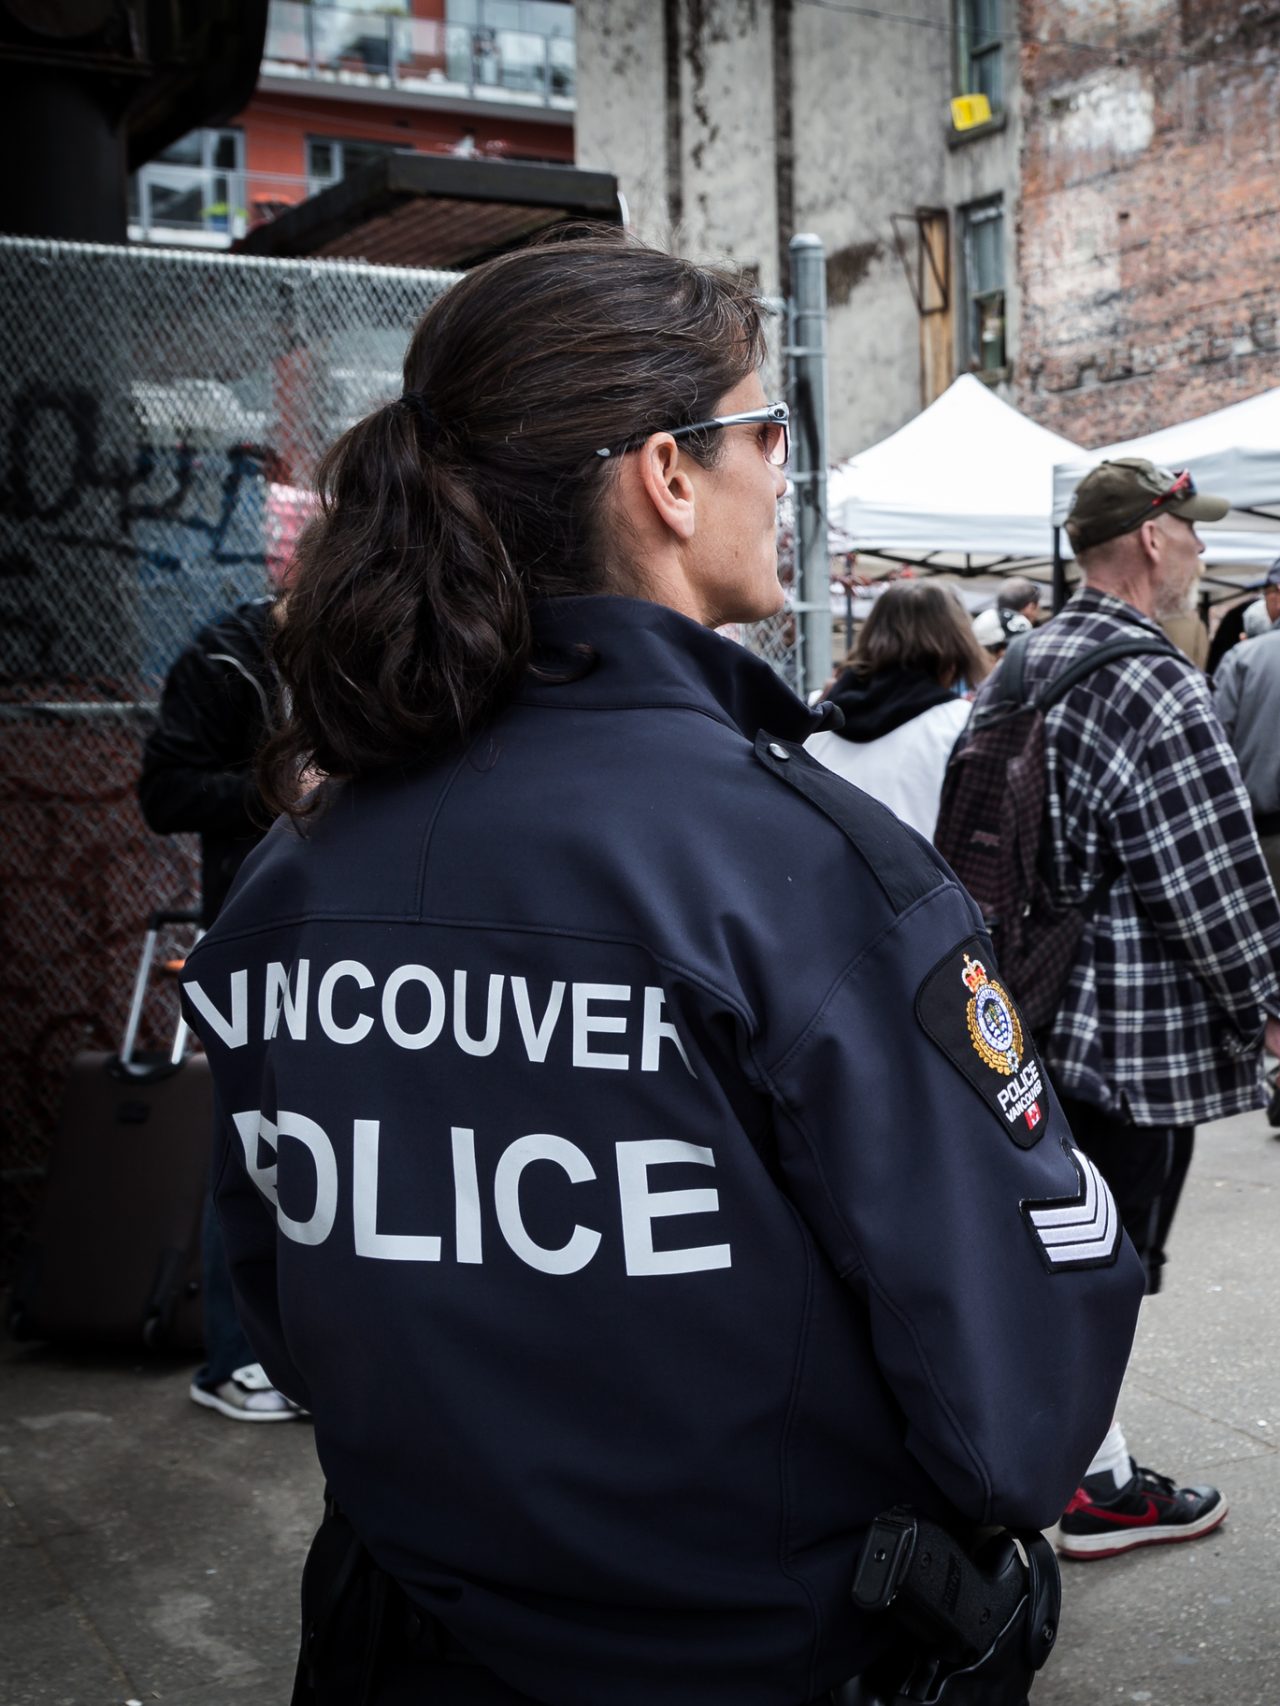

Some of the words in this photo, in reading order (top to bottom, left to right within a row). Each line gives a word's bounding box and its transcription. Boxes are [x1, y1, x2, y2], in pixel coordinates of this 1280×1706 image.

[998, 1061, 1039, 1110] POLICE
[1006, 1080, 1042, 1122] VANCOUVER
[231, 1109, 733, 1278] POLICE
